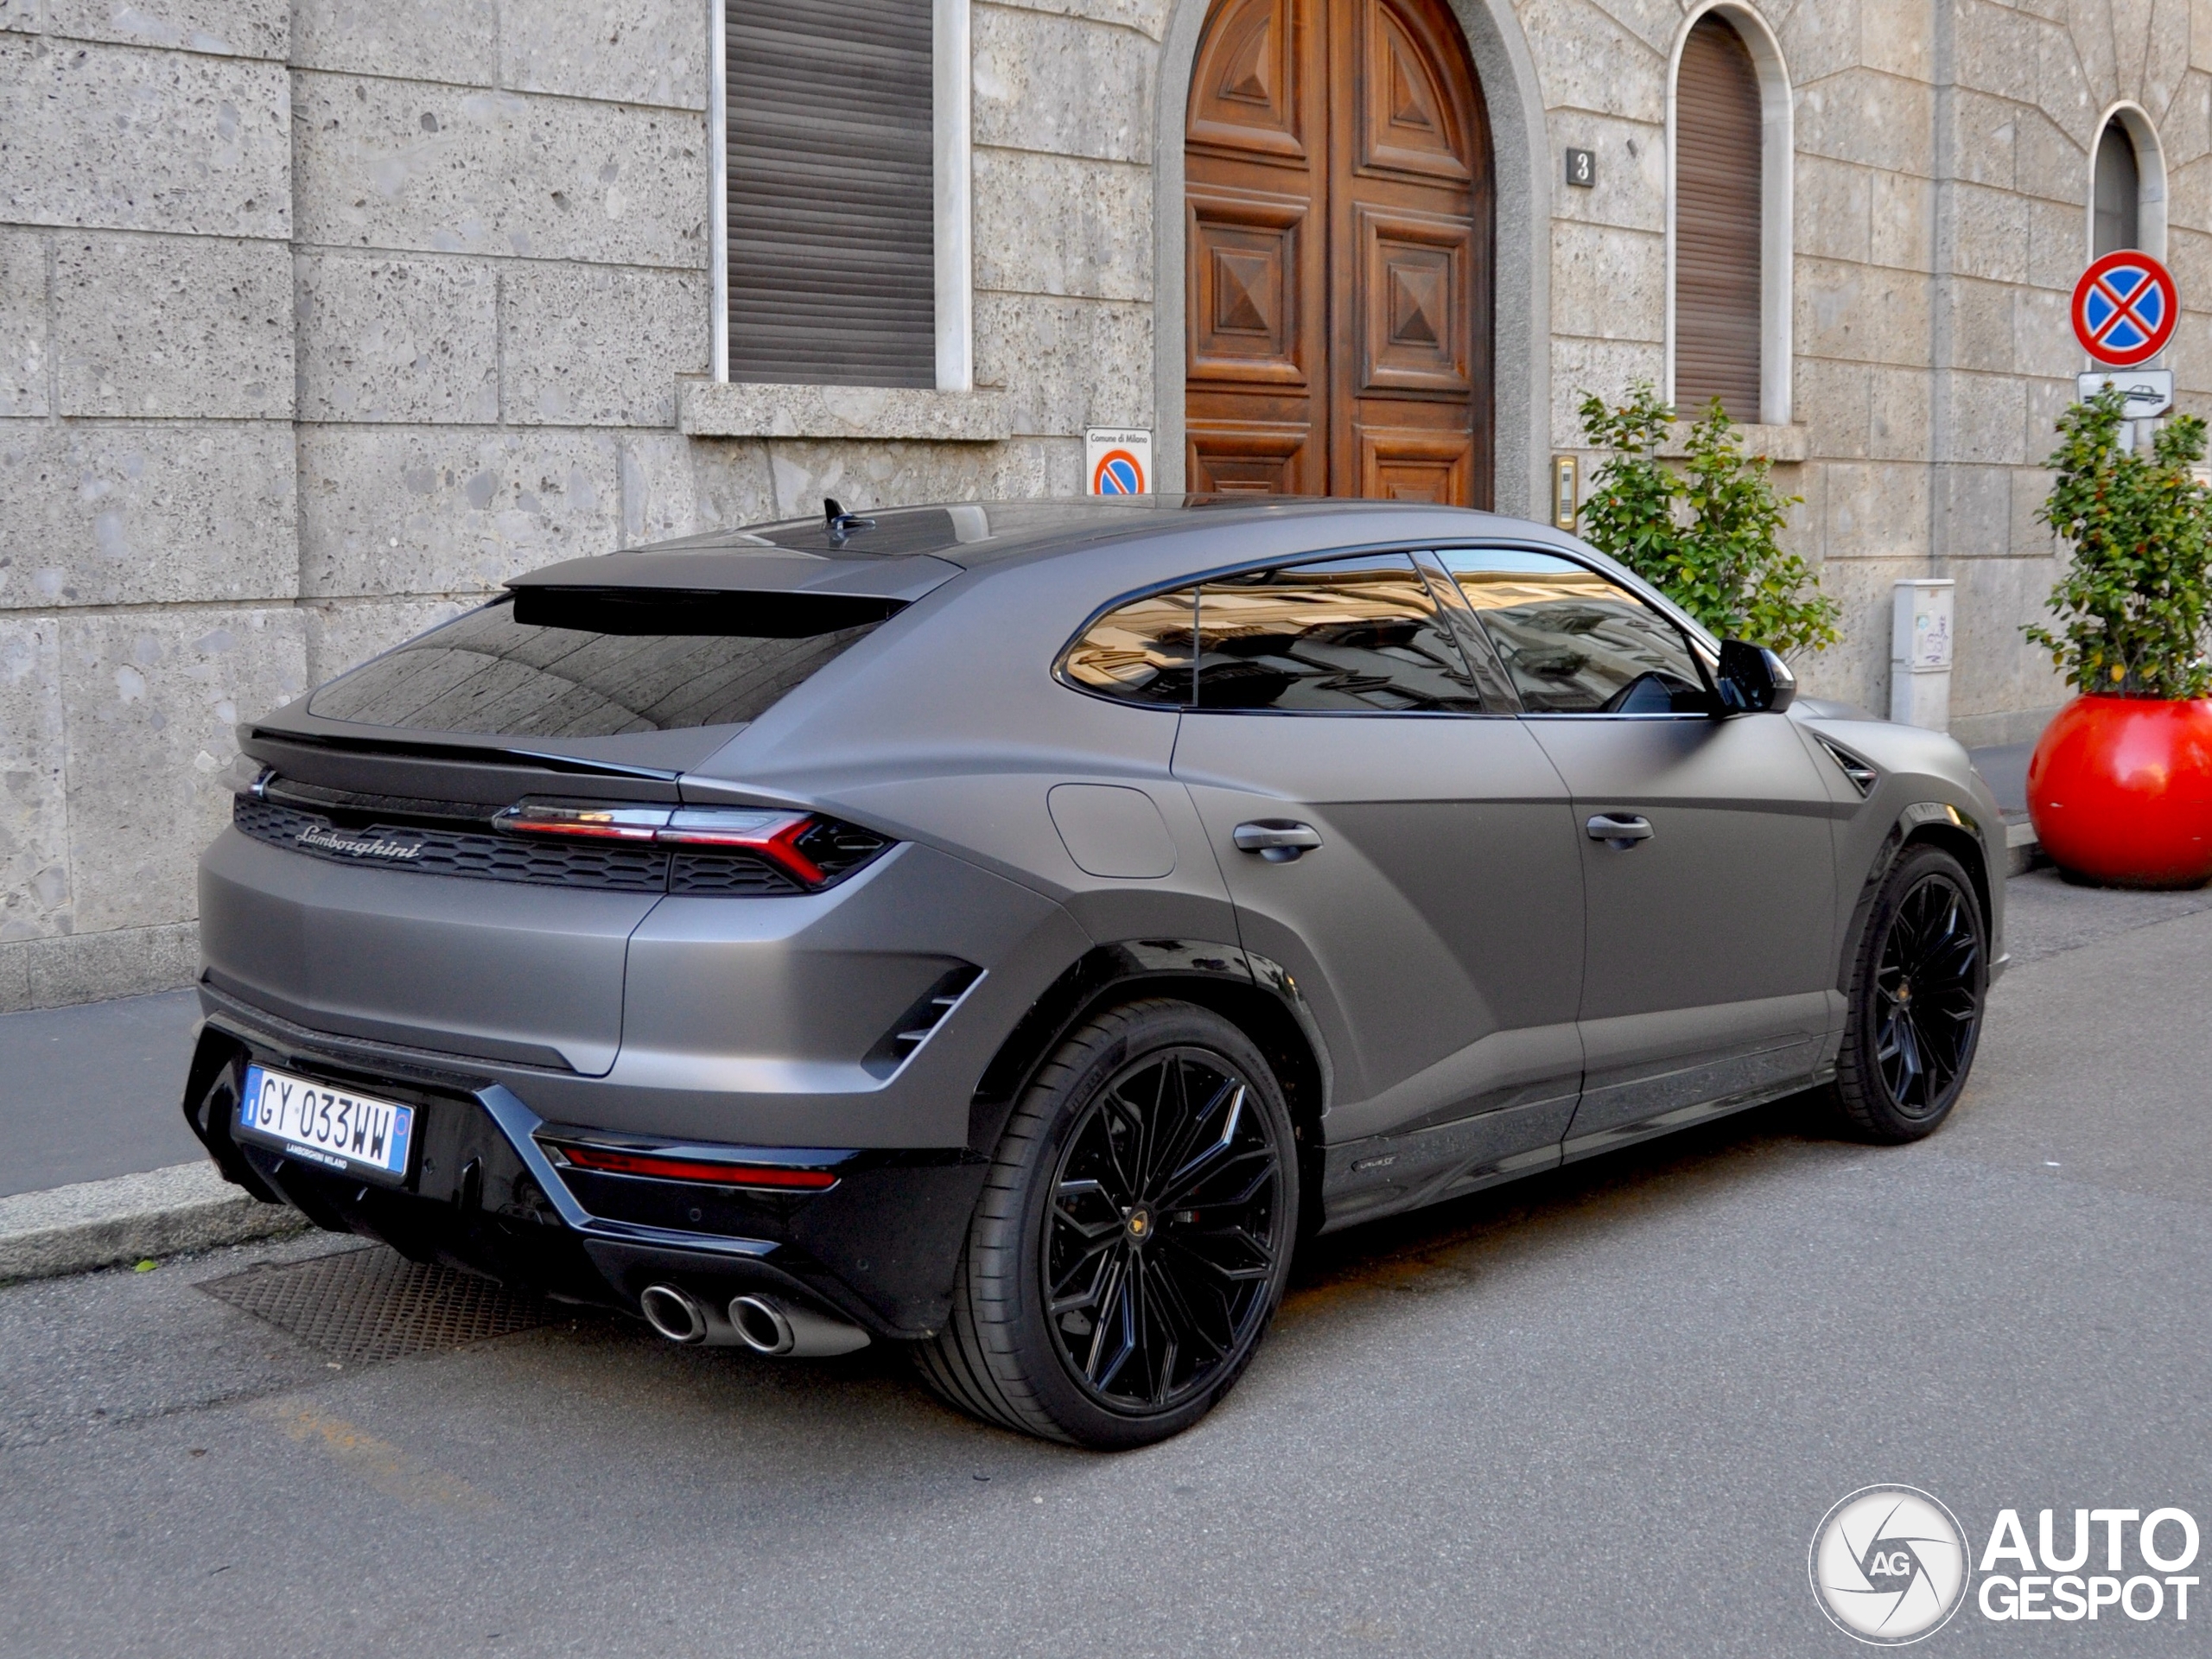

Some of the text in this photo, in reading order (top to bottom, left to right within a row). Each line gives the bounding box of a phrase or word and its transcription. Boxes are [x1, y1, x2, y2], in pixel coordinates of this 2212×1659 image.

[1577, 153, 1589, 180] 3
[1090, 433, 1147, 443] Comune di Milano
[296, 824, 422, 858] Lamborghini
[286, 1142, 347, 1170] LAMBORGHINI MILANO
